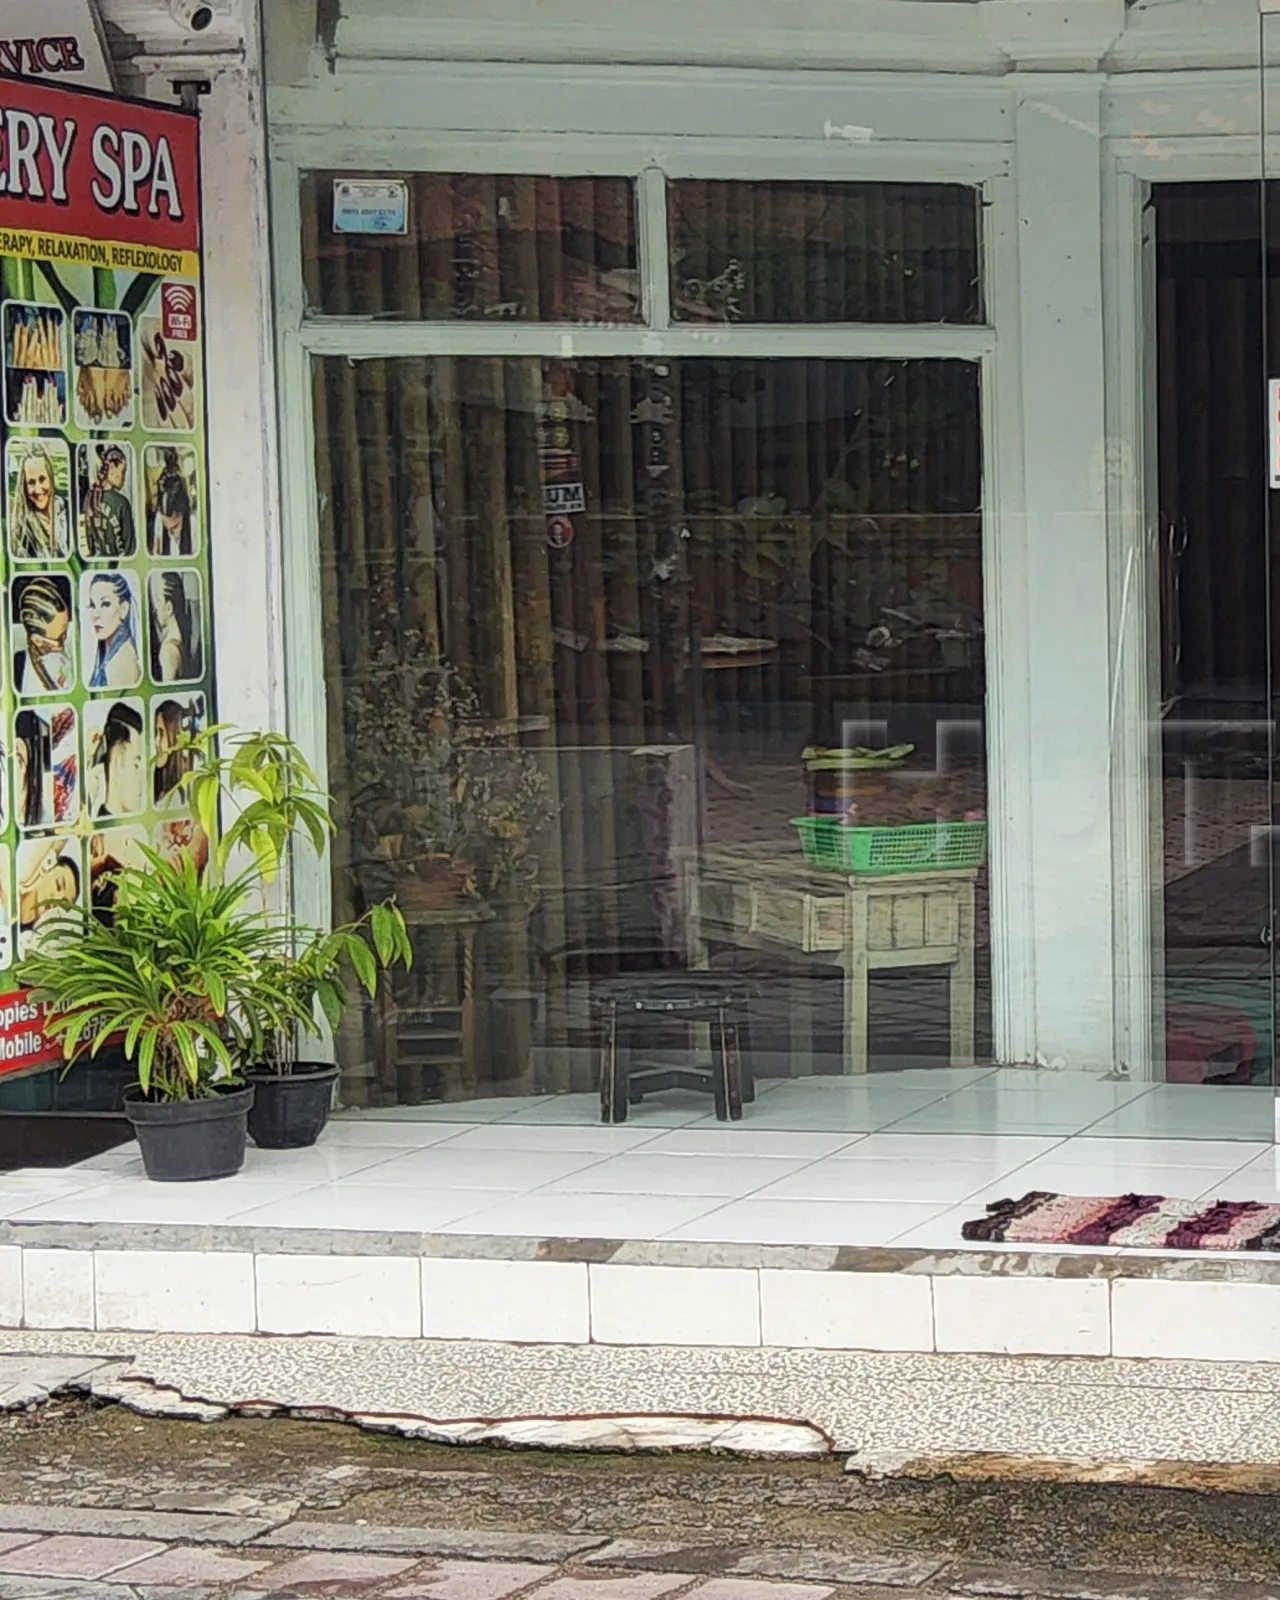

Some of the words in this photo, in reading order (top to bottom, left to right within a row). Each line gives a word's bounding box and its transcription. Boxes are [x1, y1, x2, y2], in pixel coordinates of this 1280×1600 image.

[91, 123, 184, 219] SPA
[38, 238, 110, 267] RELAXATION,
[112, 247, 183, 273] REFLEXOLOGY
